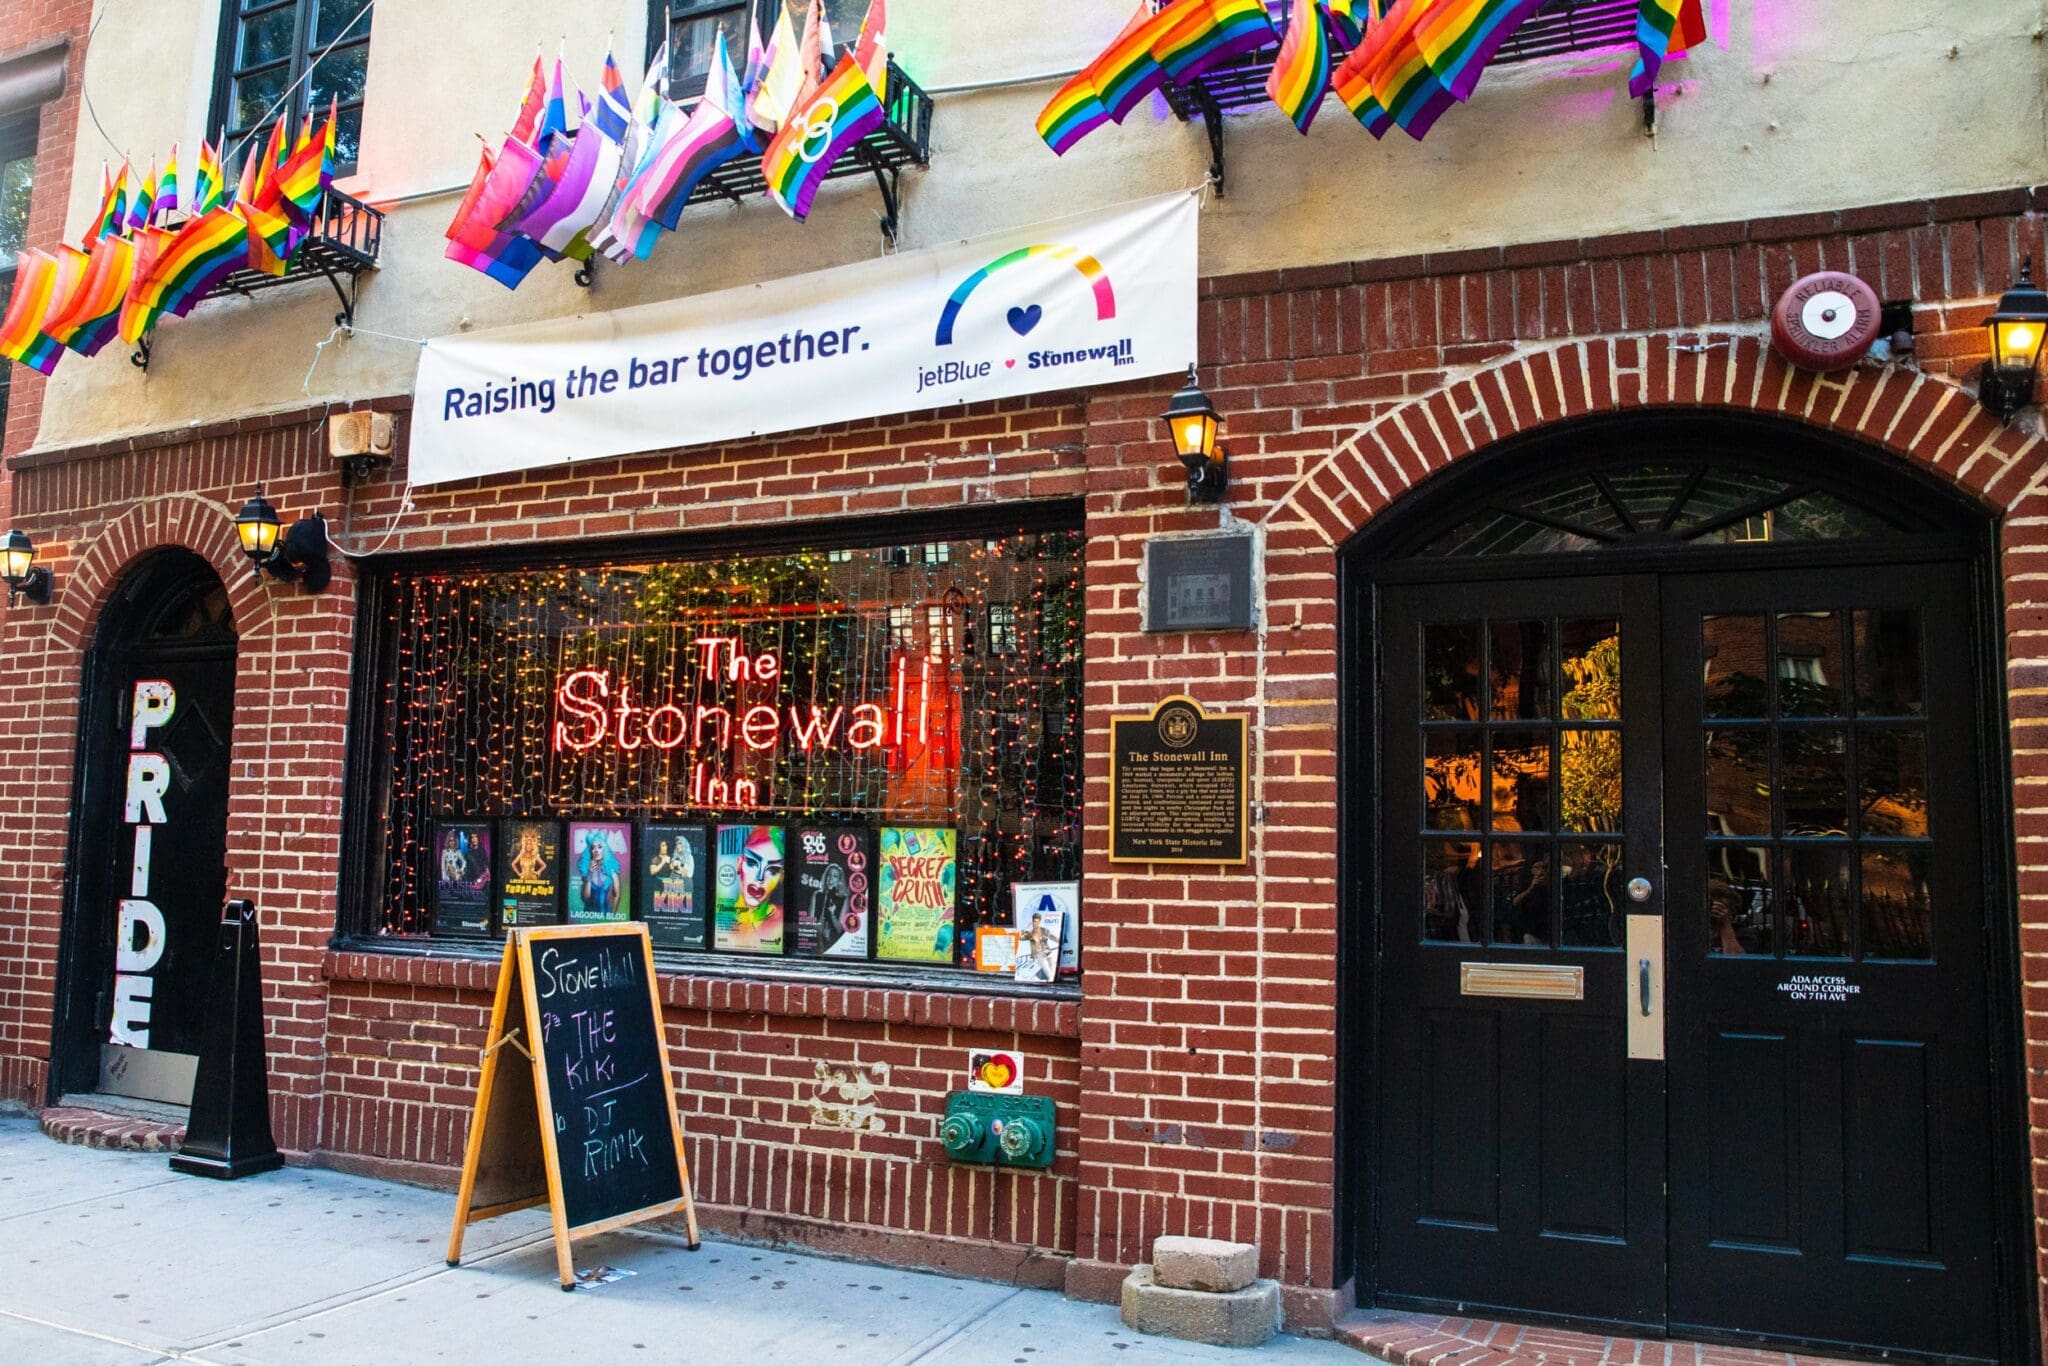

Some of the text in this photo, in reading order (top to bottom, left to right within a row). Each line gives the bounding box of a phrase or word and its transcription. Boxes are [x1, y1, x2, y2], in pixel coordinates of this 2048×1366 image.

[1795, 280, 1862, 303] RELIABLE
[1786, 308, 1871, 353] SPRINKLER ALARM
[1027, 338, 1133, 370] Stonewall
[1113, 355, 1136, 367] Inn
[443, 324, 871, 421] Raising the bar together.
[917, 360, 992, 394] jetBlue
[694, 636, 779, 682] The
[555, 655, 931, 752] Stonewall
[1128, 751, 1229, 762] The Stonewall Inn
[690, 762, 758, 806] Inn
[1132, 838, 1223, 847] New York State Historic Site
[109, 679, 177, 1050] PRIDE
[889, 855, 952, 881] SECRET
[653, 891, 693, 914] KIKI
[892, 878, 947, 909] CRUSH
[570, 911, 627, 921] LAGOONA BLOO
[1777, 983, 1860, 994] AROUND CORNER
[1790, 975, 1846, 985] ADA ACCESS
[1791, 991, 1847, 1001] ON 7TH AVE
[571, 1010, 617, 1059] THE
